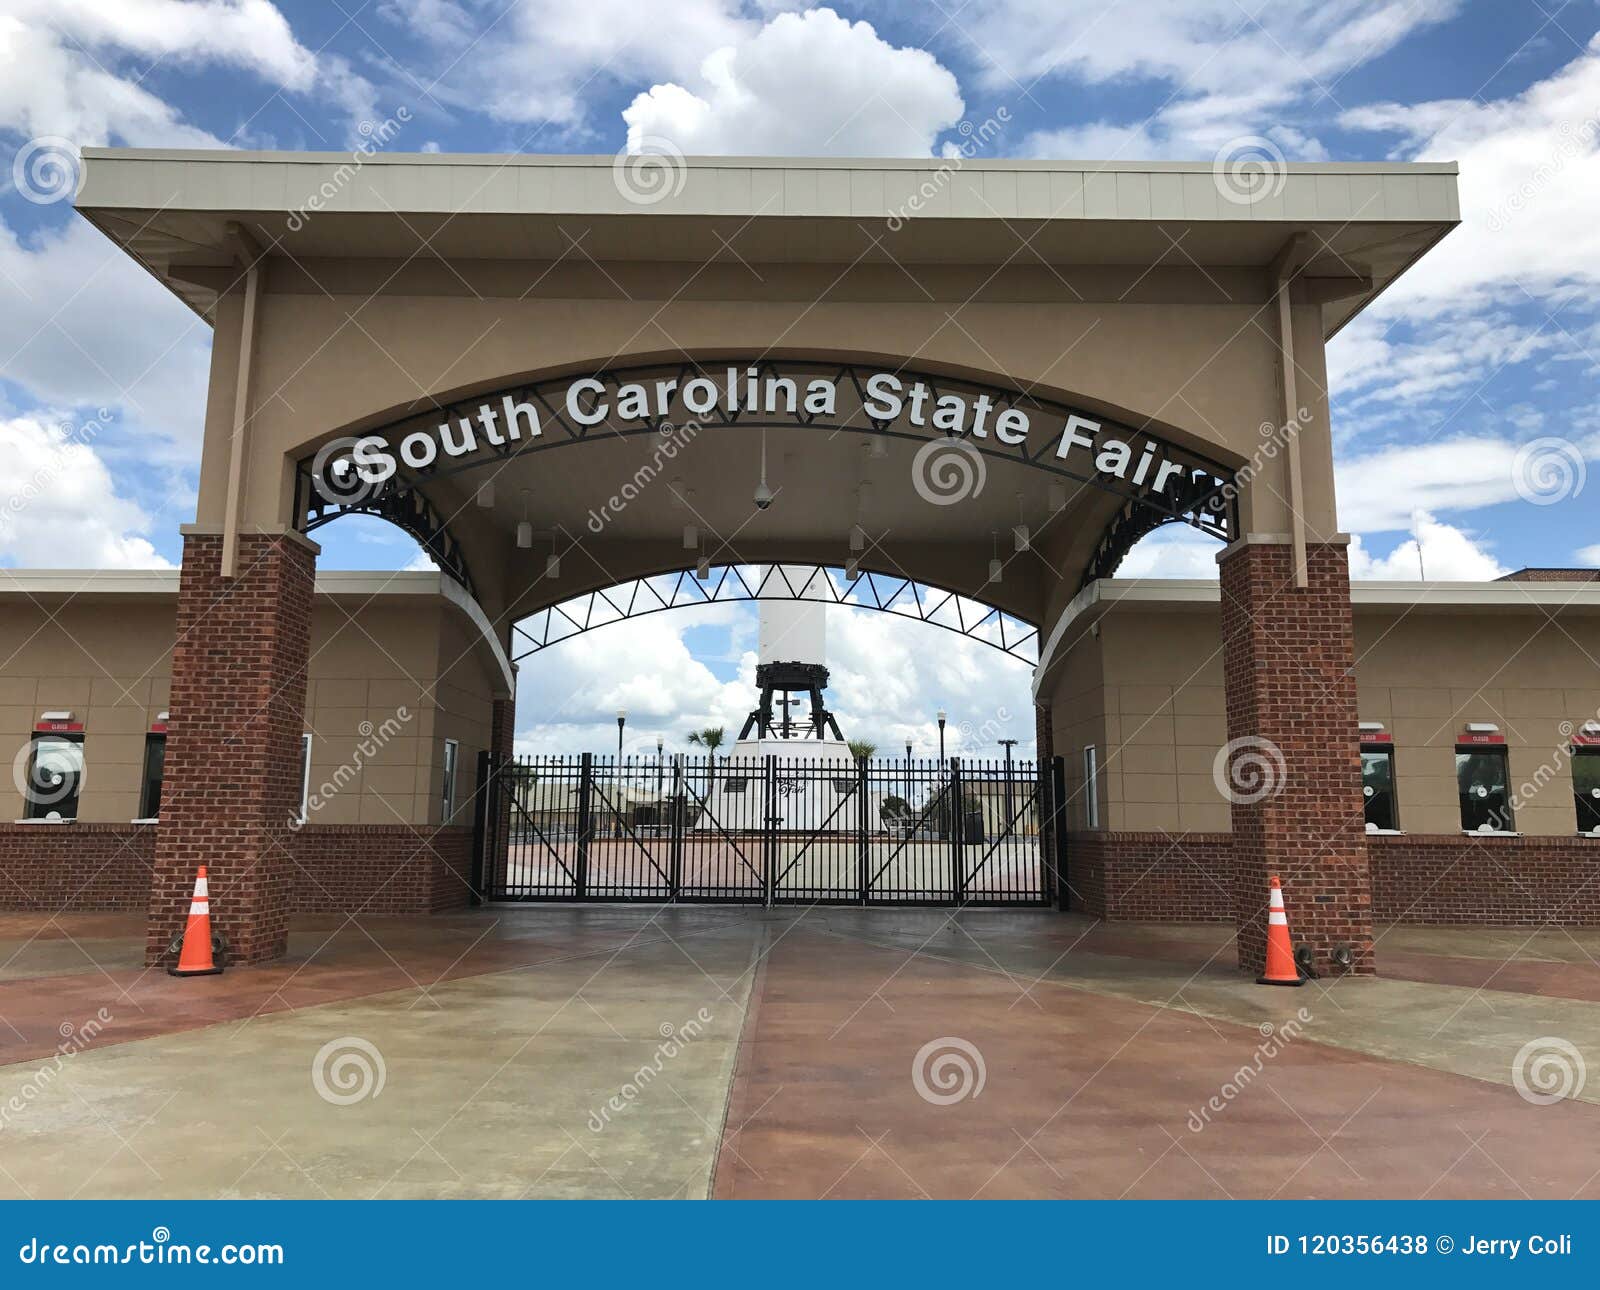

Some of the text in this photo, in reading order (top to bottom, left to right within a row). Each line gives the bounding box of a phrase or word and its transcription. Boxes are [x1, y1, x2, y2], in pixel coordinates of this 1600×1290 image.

[353, 367, 1183, 493] South Carolina State Fair
